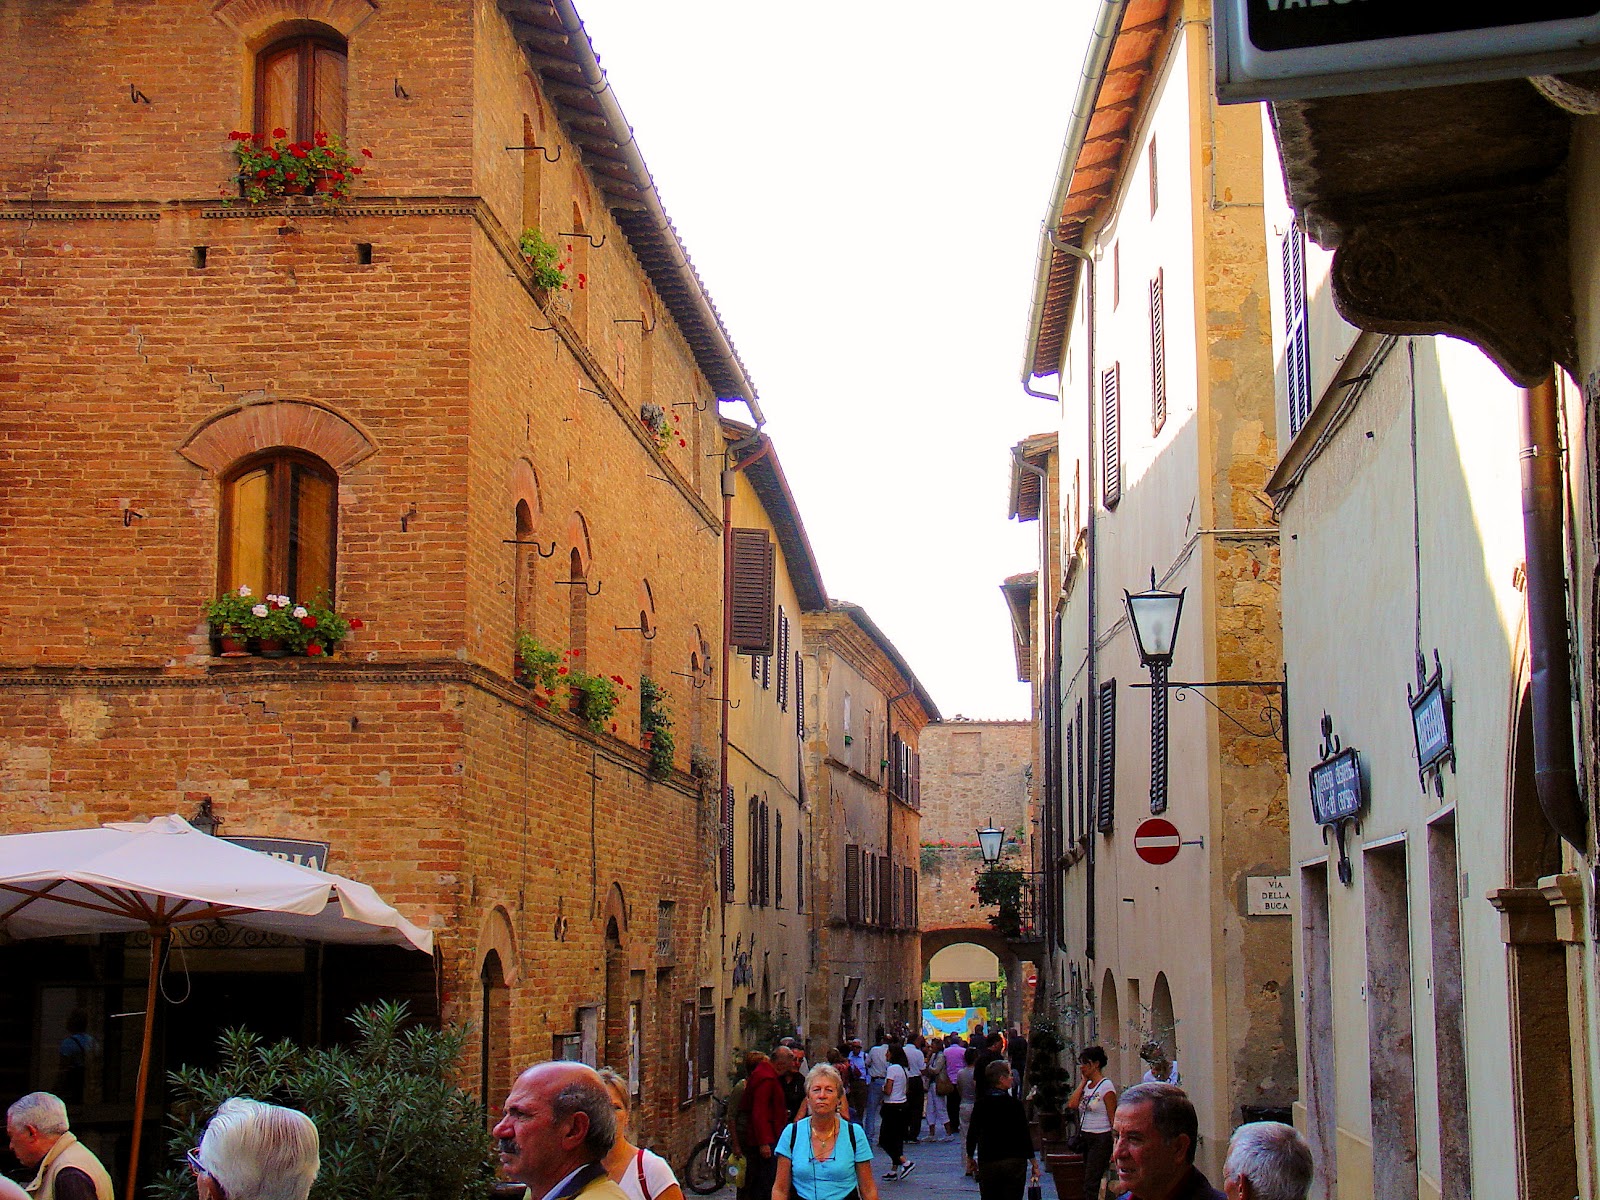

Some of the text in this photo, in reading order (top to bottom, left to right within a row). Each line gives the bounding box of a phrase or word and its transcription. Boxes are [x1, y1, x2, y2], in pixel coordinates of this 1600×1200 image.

[1268, 881, 1283, 889] VIA
[1261, 892, 1291, 900] DELLA
[1265, 902, 1288, 910] BUCA
